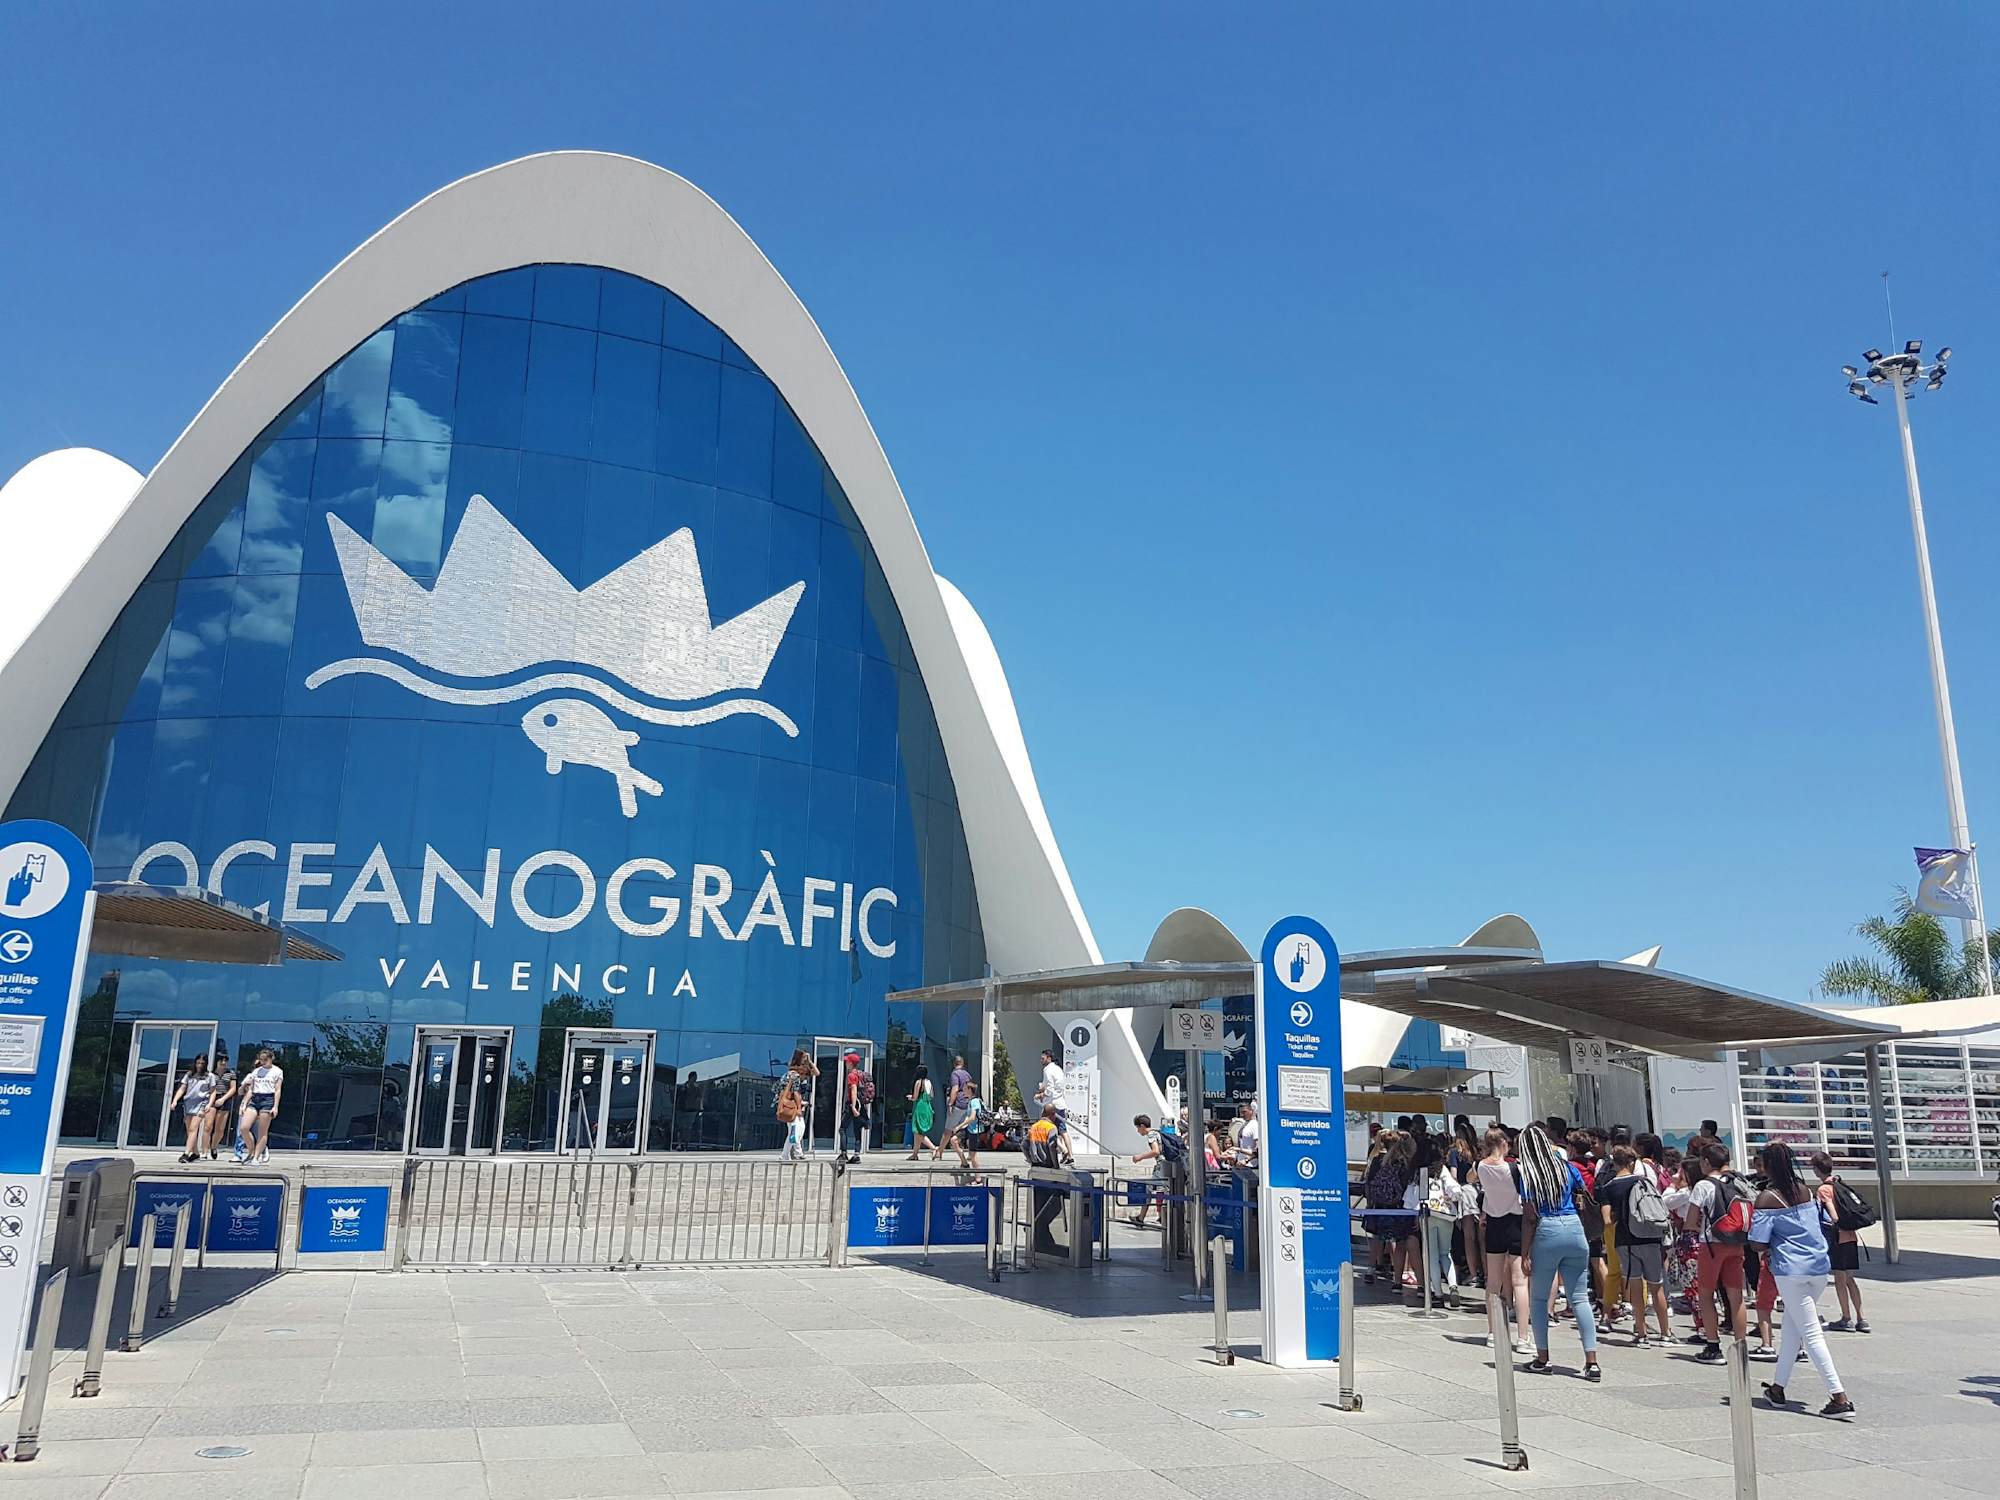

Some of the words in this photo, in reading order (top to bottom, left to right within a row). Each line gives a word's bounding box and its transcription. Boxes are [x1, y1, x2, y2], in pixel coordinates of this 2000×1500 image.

[127, 839, 898, 959] OCEANOGRÀFIC
[378, 957, 698, 998] VALENCIA
[8, 986, 33, 995] office
[1284, 1032, 1321, 1044] Taquillas
[1280, 1118, 1331, 1129] Bienvenidos
[231, 1218, 243, 1229] 15
[332, 1219, 344, 1231] 15
[877, 1216, 887, 1227] 15
[954, 1215, 963, 1225] 15
